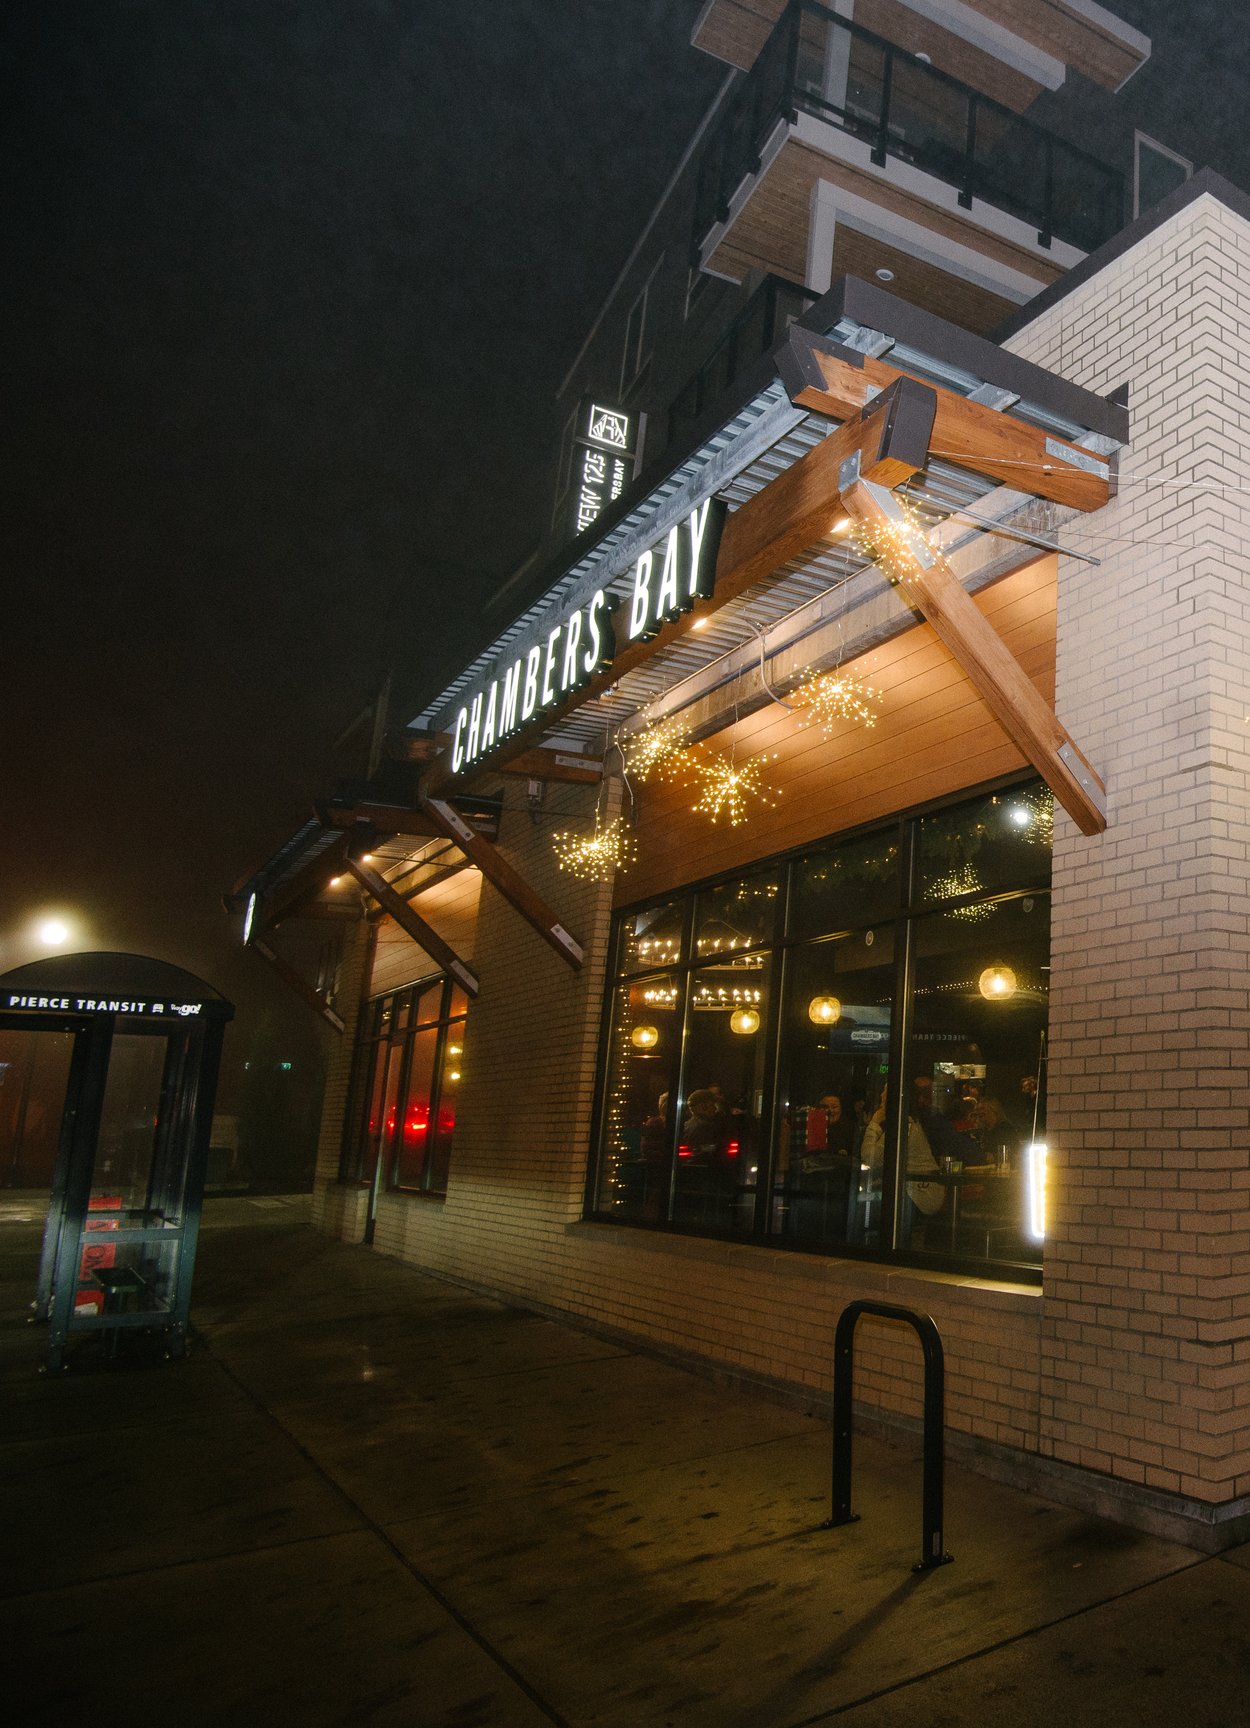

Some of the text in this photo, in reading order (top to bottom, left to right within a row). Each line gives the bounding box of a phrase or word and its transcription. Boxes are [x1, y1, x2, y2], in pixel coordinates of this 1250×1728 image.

[451, 496, 712, 774] CHAMBERS BAY
[9, 996, 146, 1013] PIERCE TRANSIT
